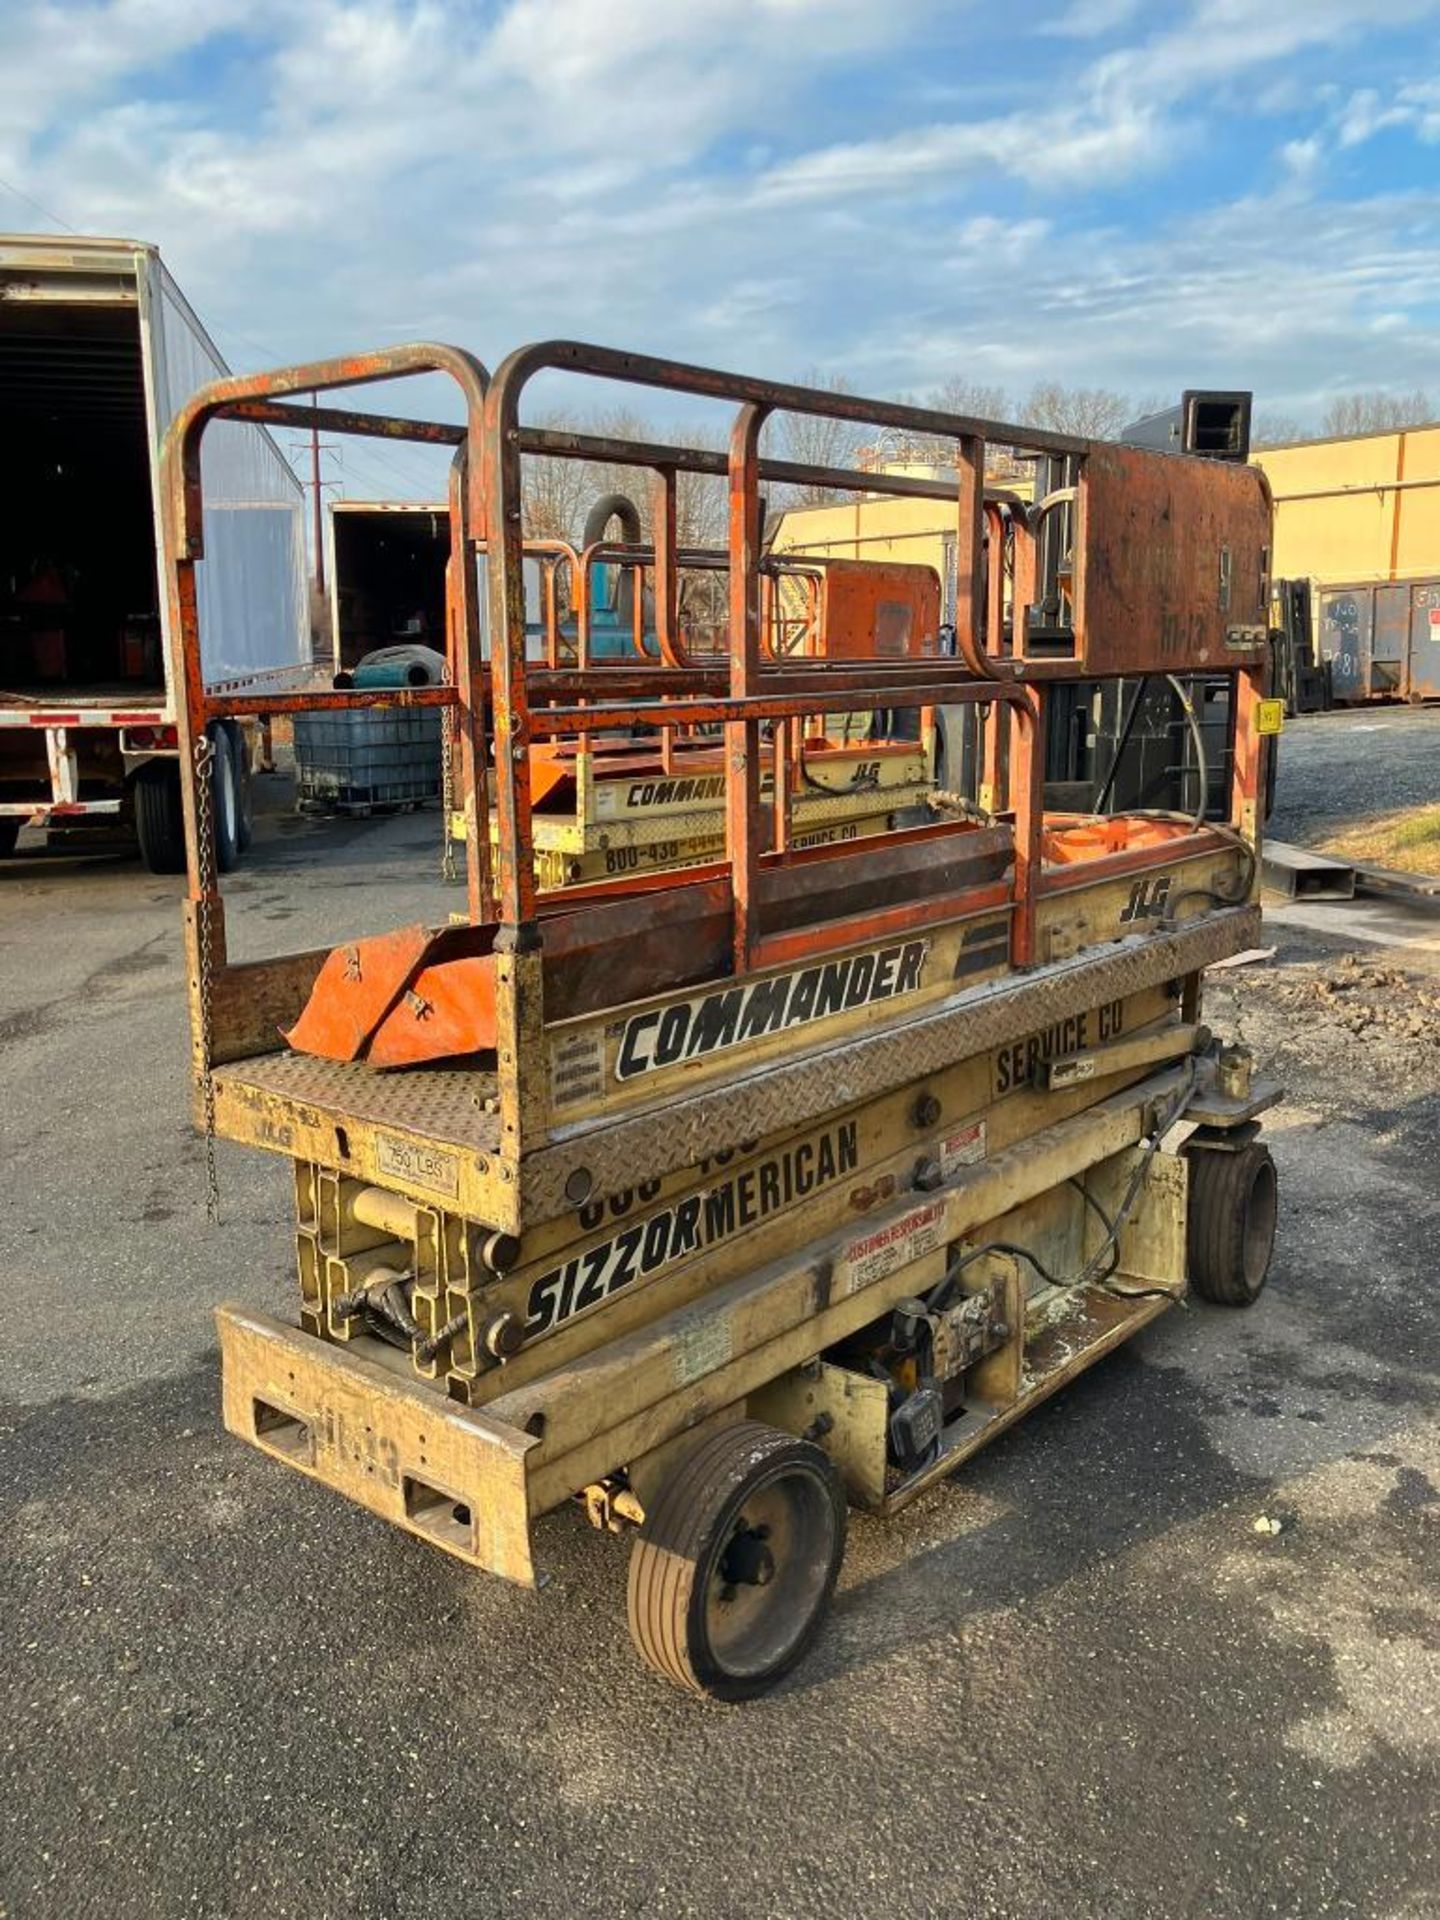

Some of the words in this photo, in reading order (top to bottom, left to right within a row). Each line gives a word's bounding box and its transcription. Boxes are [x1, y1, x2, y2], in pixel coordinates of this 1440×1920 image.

[627, 777, 726, 808] COMMAN
[619, 941, 926, 1079] COMMANDER
[1099, 1000, 1122, 1041] CO
